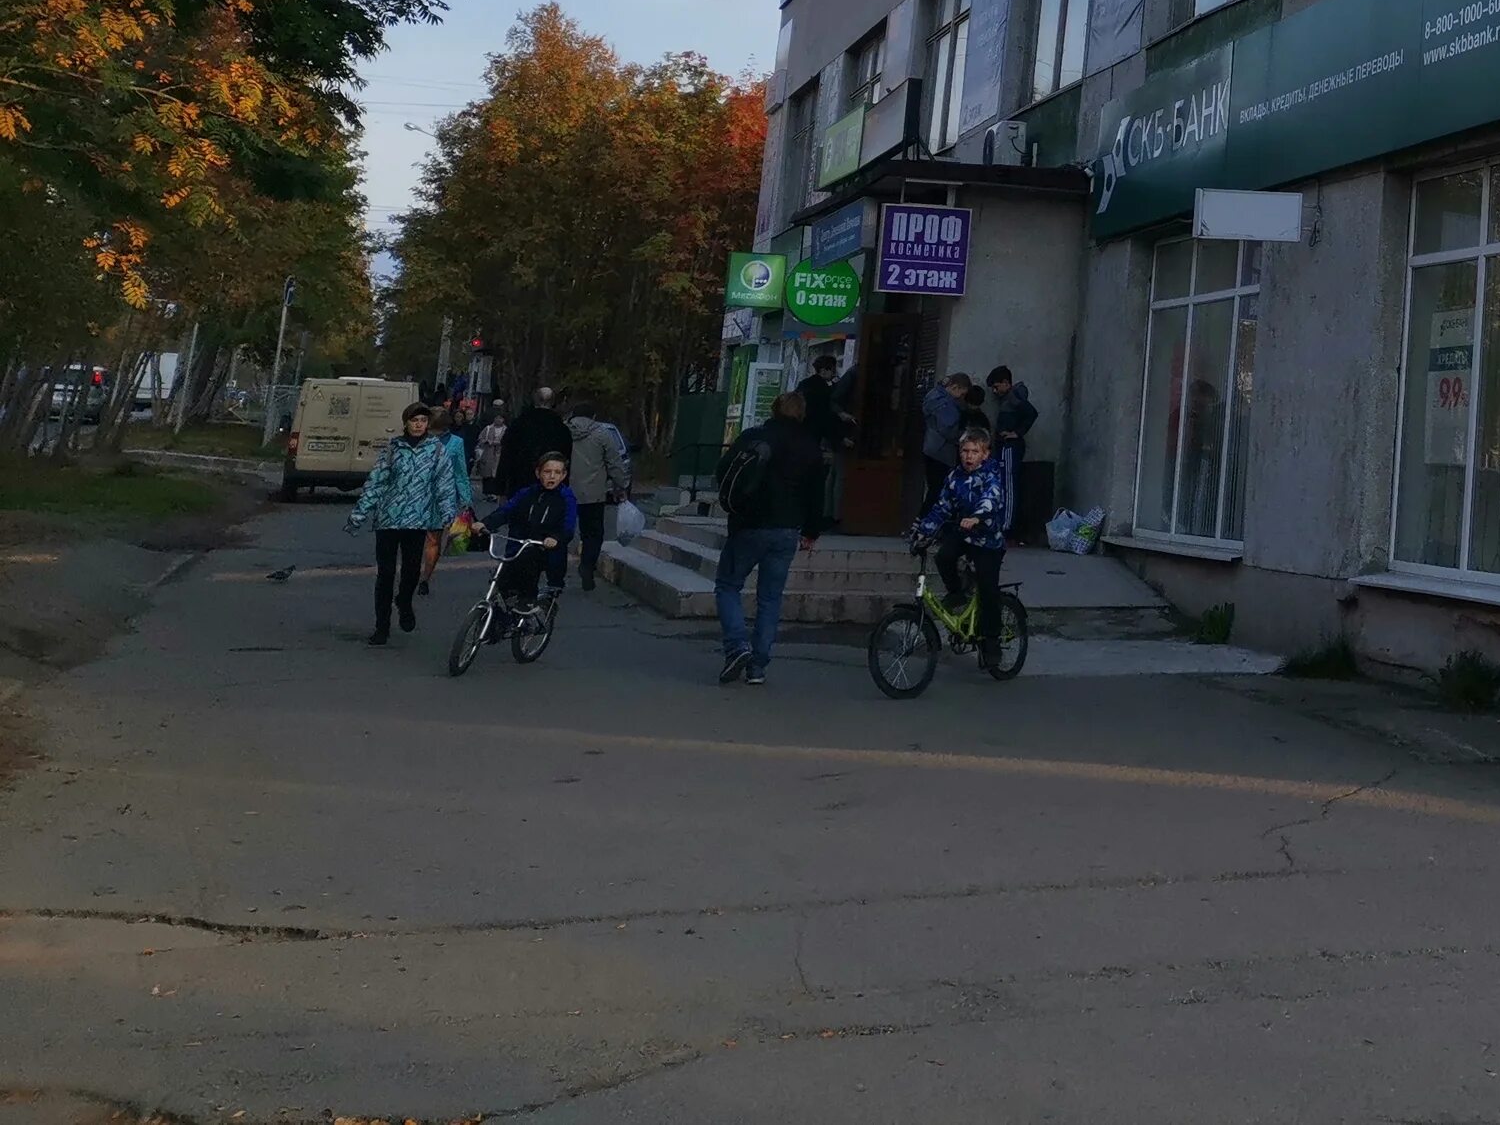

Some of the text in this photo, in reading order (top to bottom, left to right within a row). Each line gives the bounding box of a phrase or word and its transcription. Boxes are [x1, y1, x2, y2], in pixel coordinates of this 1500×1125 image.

[1240, 49, 1404, 125] ВКЛАДЫ, КРЕДИТЫ, ДЕНЕЖНЫЕ ПЕРЕВОДЫ
[891, 212, 963, 244] ПРОФ
[886, 264, 958, 289] 2 этаж
[808, 293, 848, 308] этаж
